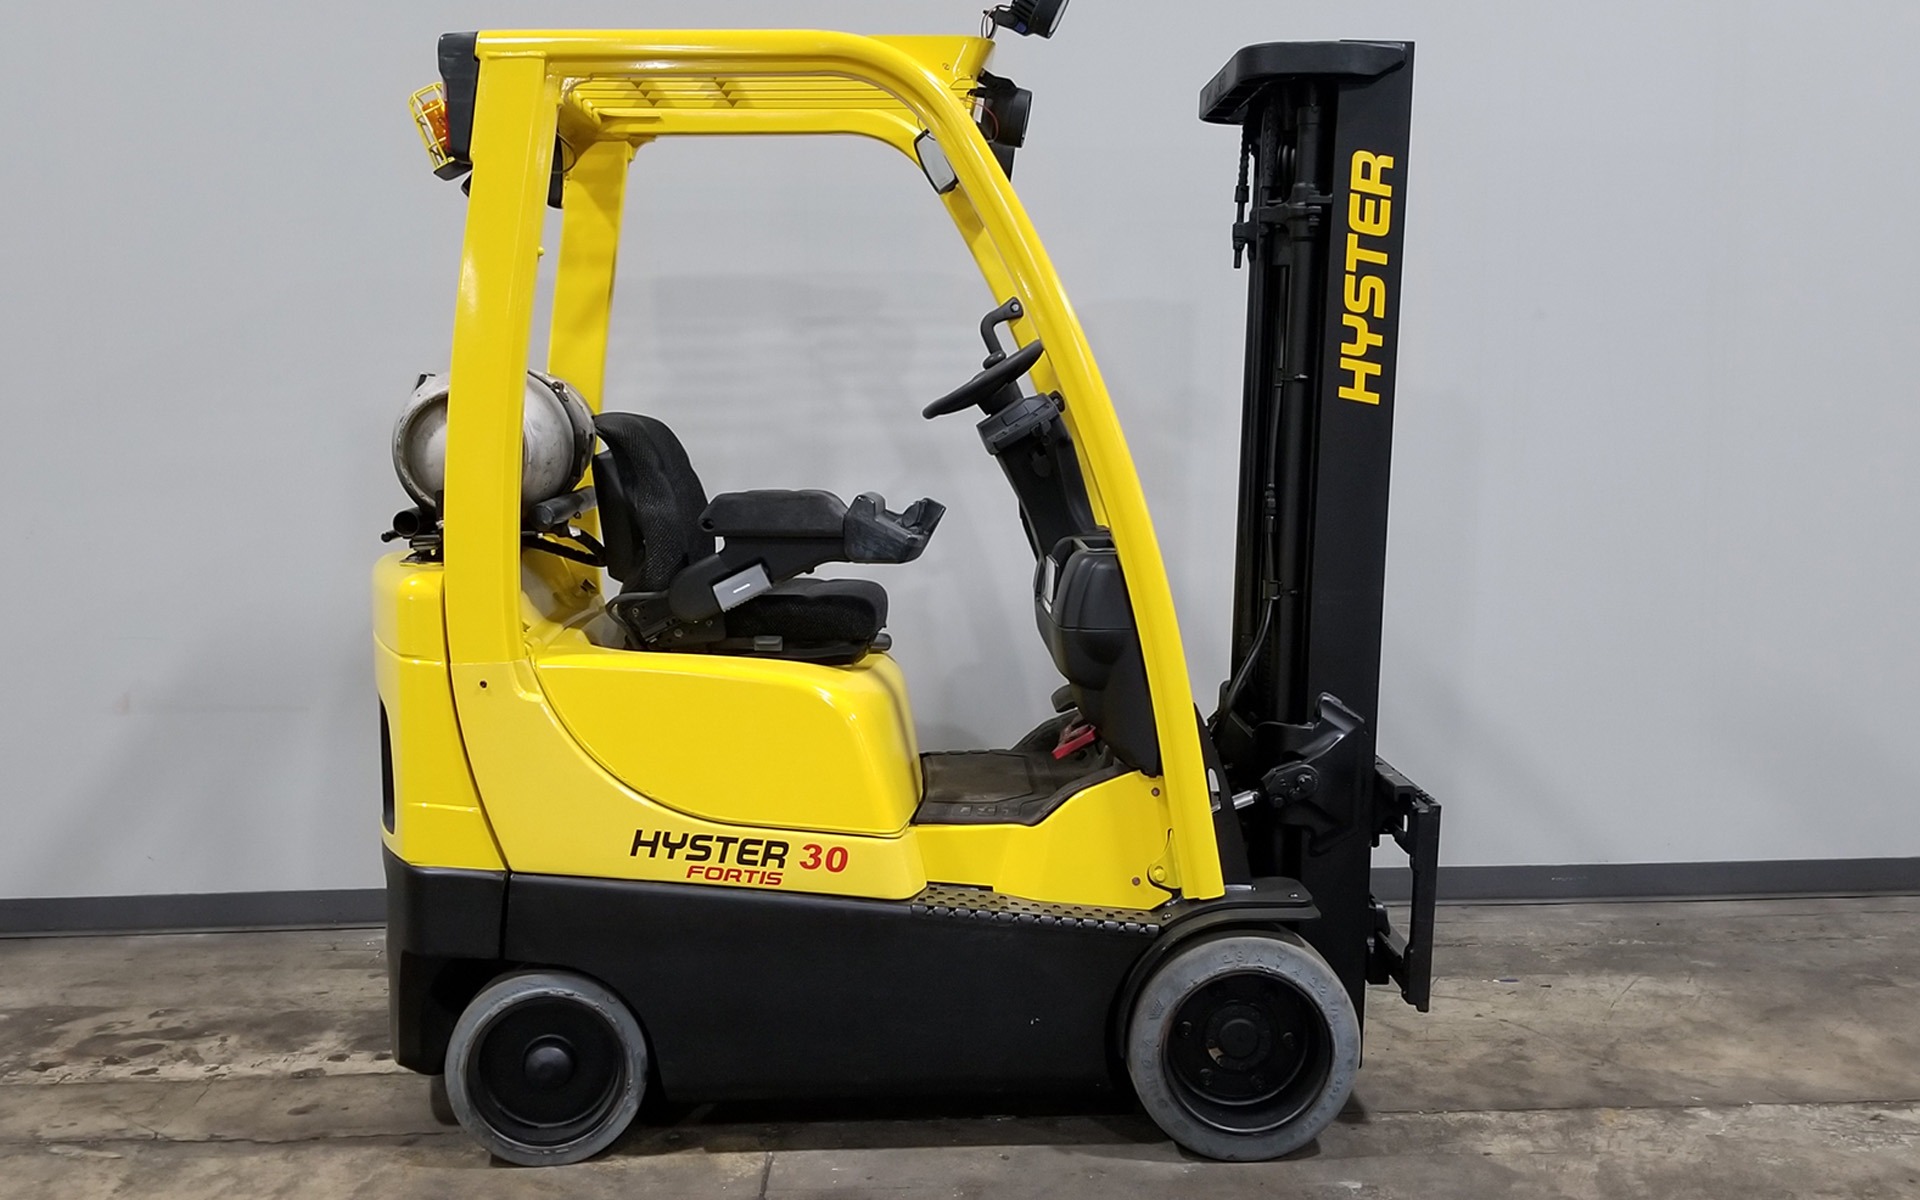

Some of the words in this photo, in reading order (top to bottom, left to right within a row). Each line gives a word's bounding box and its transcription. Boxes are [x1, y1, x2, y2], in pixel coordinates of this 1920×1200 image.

[1338, 150, 1394, 405] HYSTER
[630, 829, 789, 868] HYSTER
[799, 843, 848, 873] 30
[686, 866, 783, 885] FORTIS
